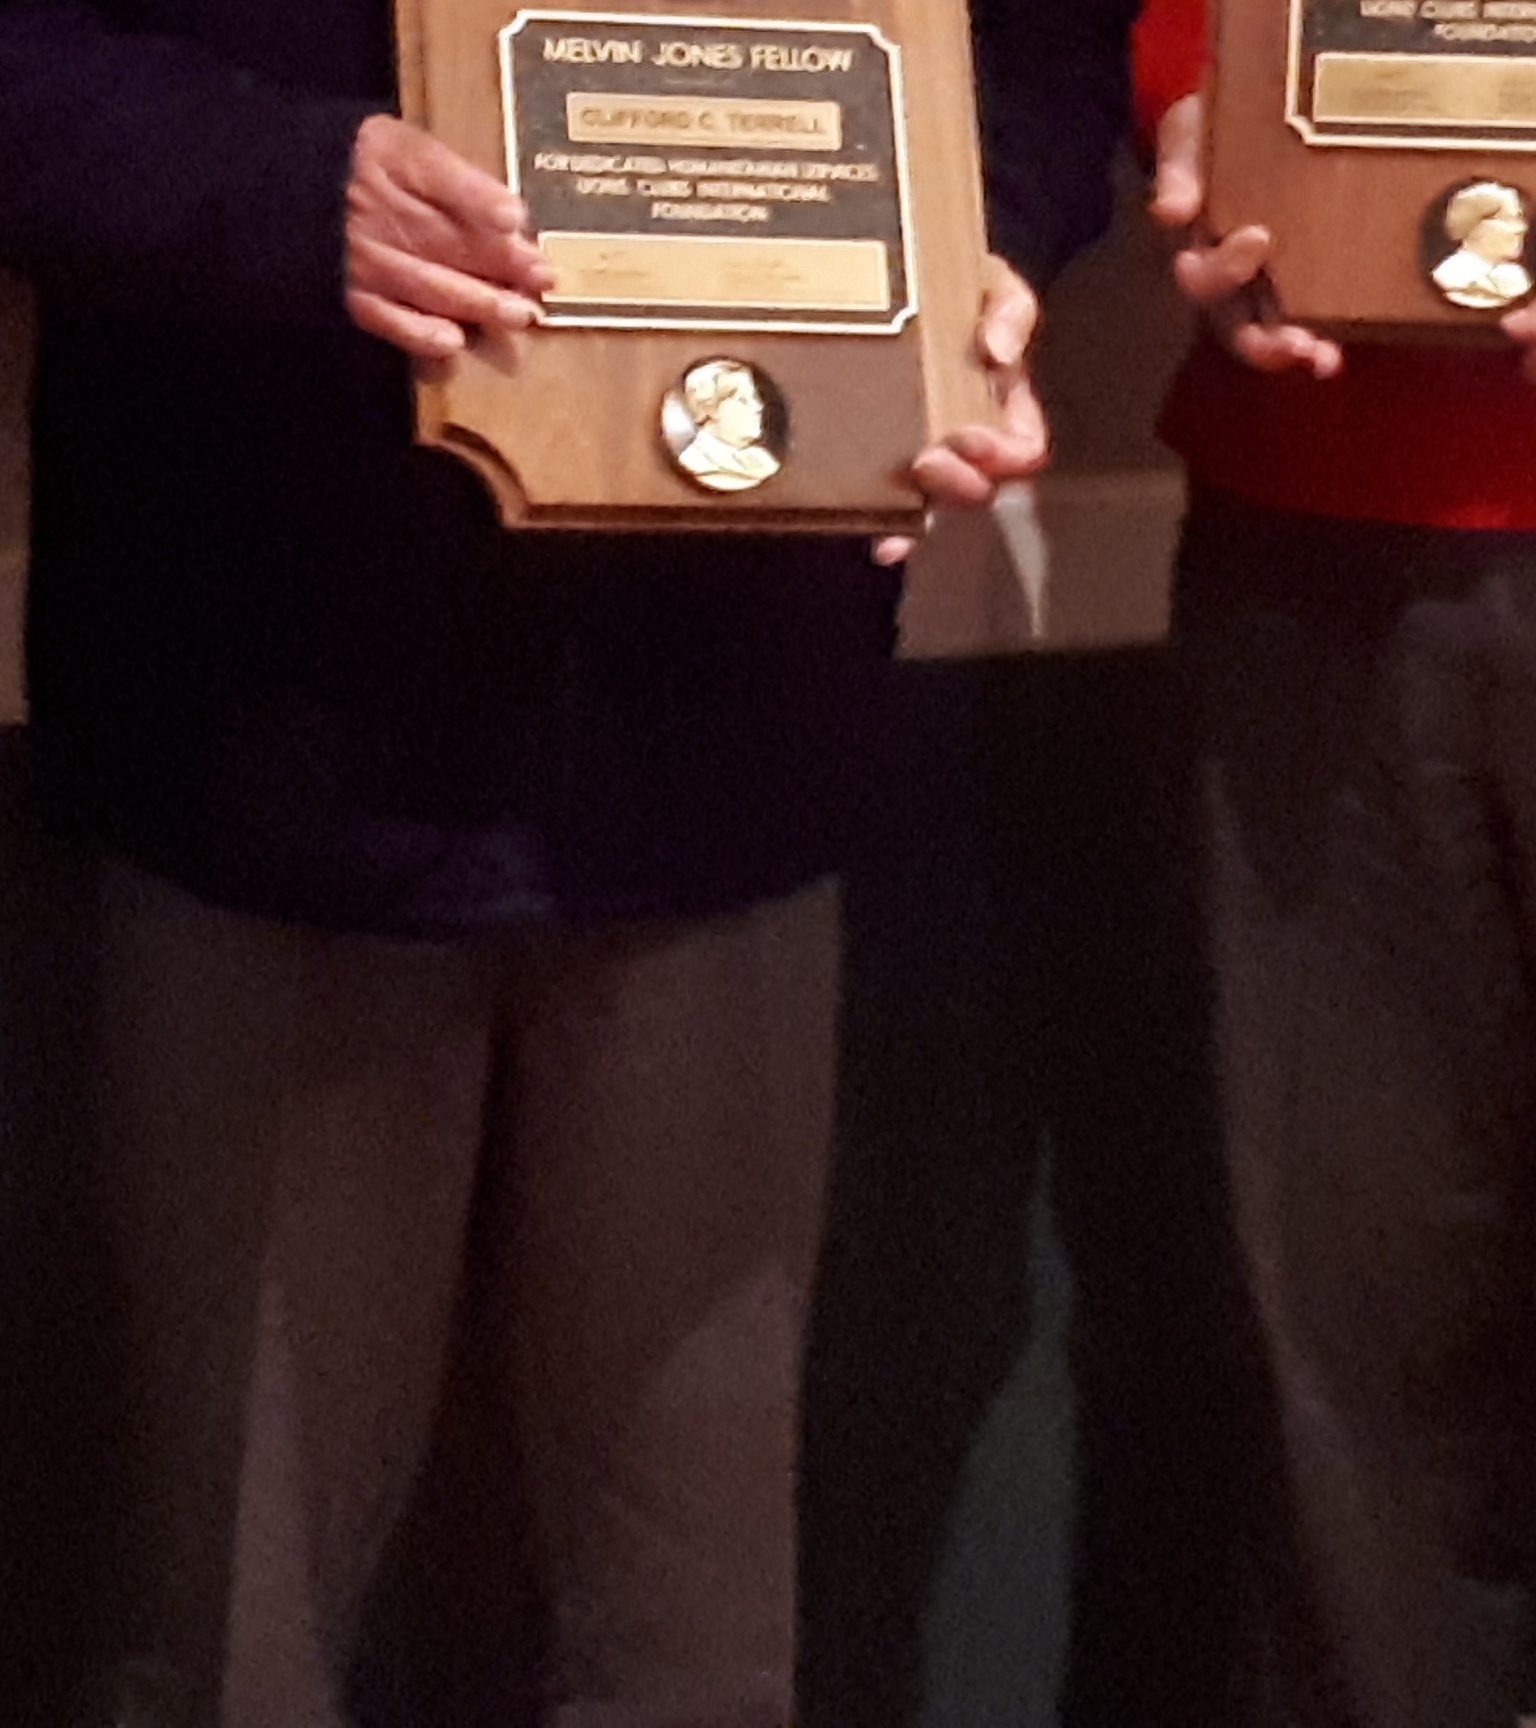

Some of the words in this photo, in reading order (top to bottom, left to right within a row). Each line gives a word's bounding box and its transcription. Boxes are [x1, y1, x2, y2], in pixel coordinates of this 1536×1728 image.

[543, 37, 644, 64] MELVIN
[652, 41, 743, 69] JONES
[751, 44, 854, 71] FELLOW
[581, 106, 693, 130] CLIFFORD
